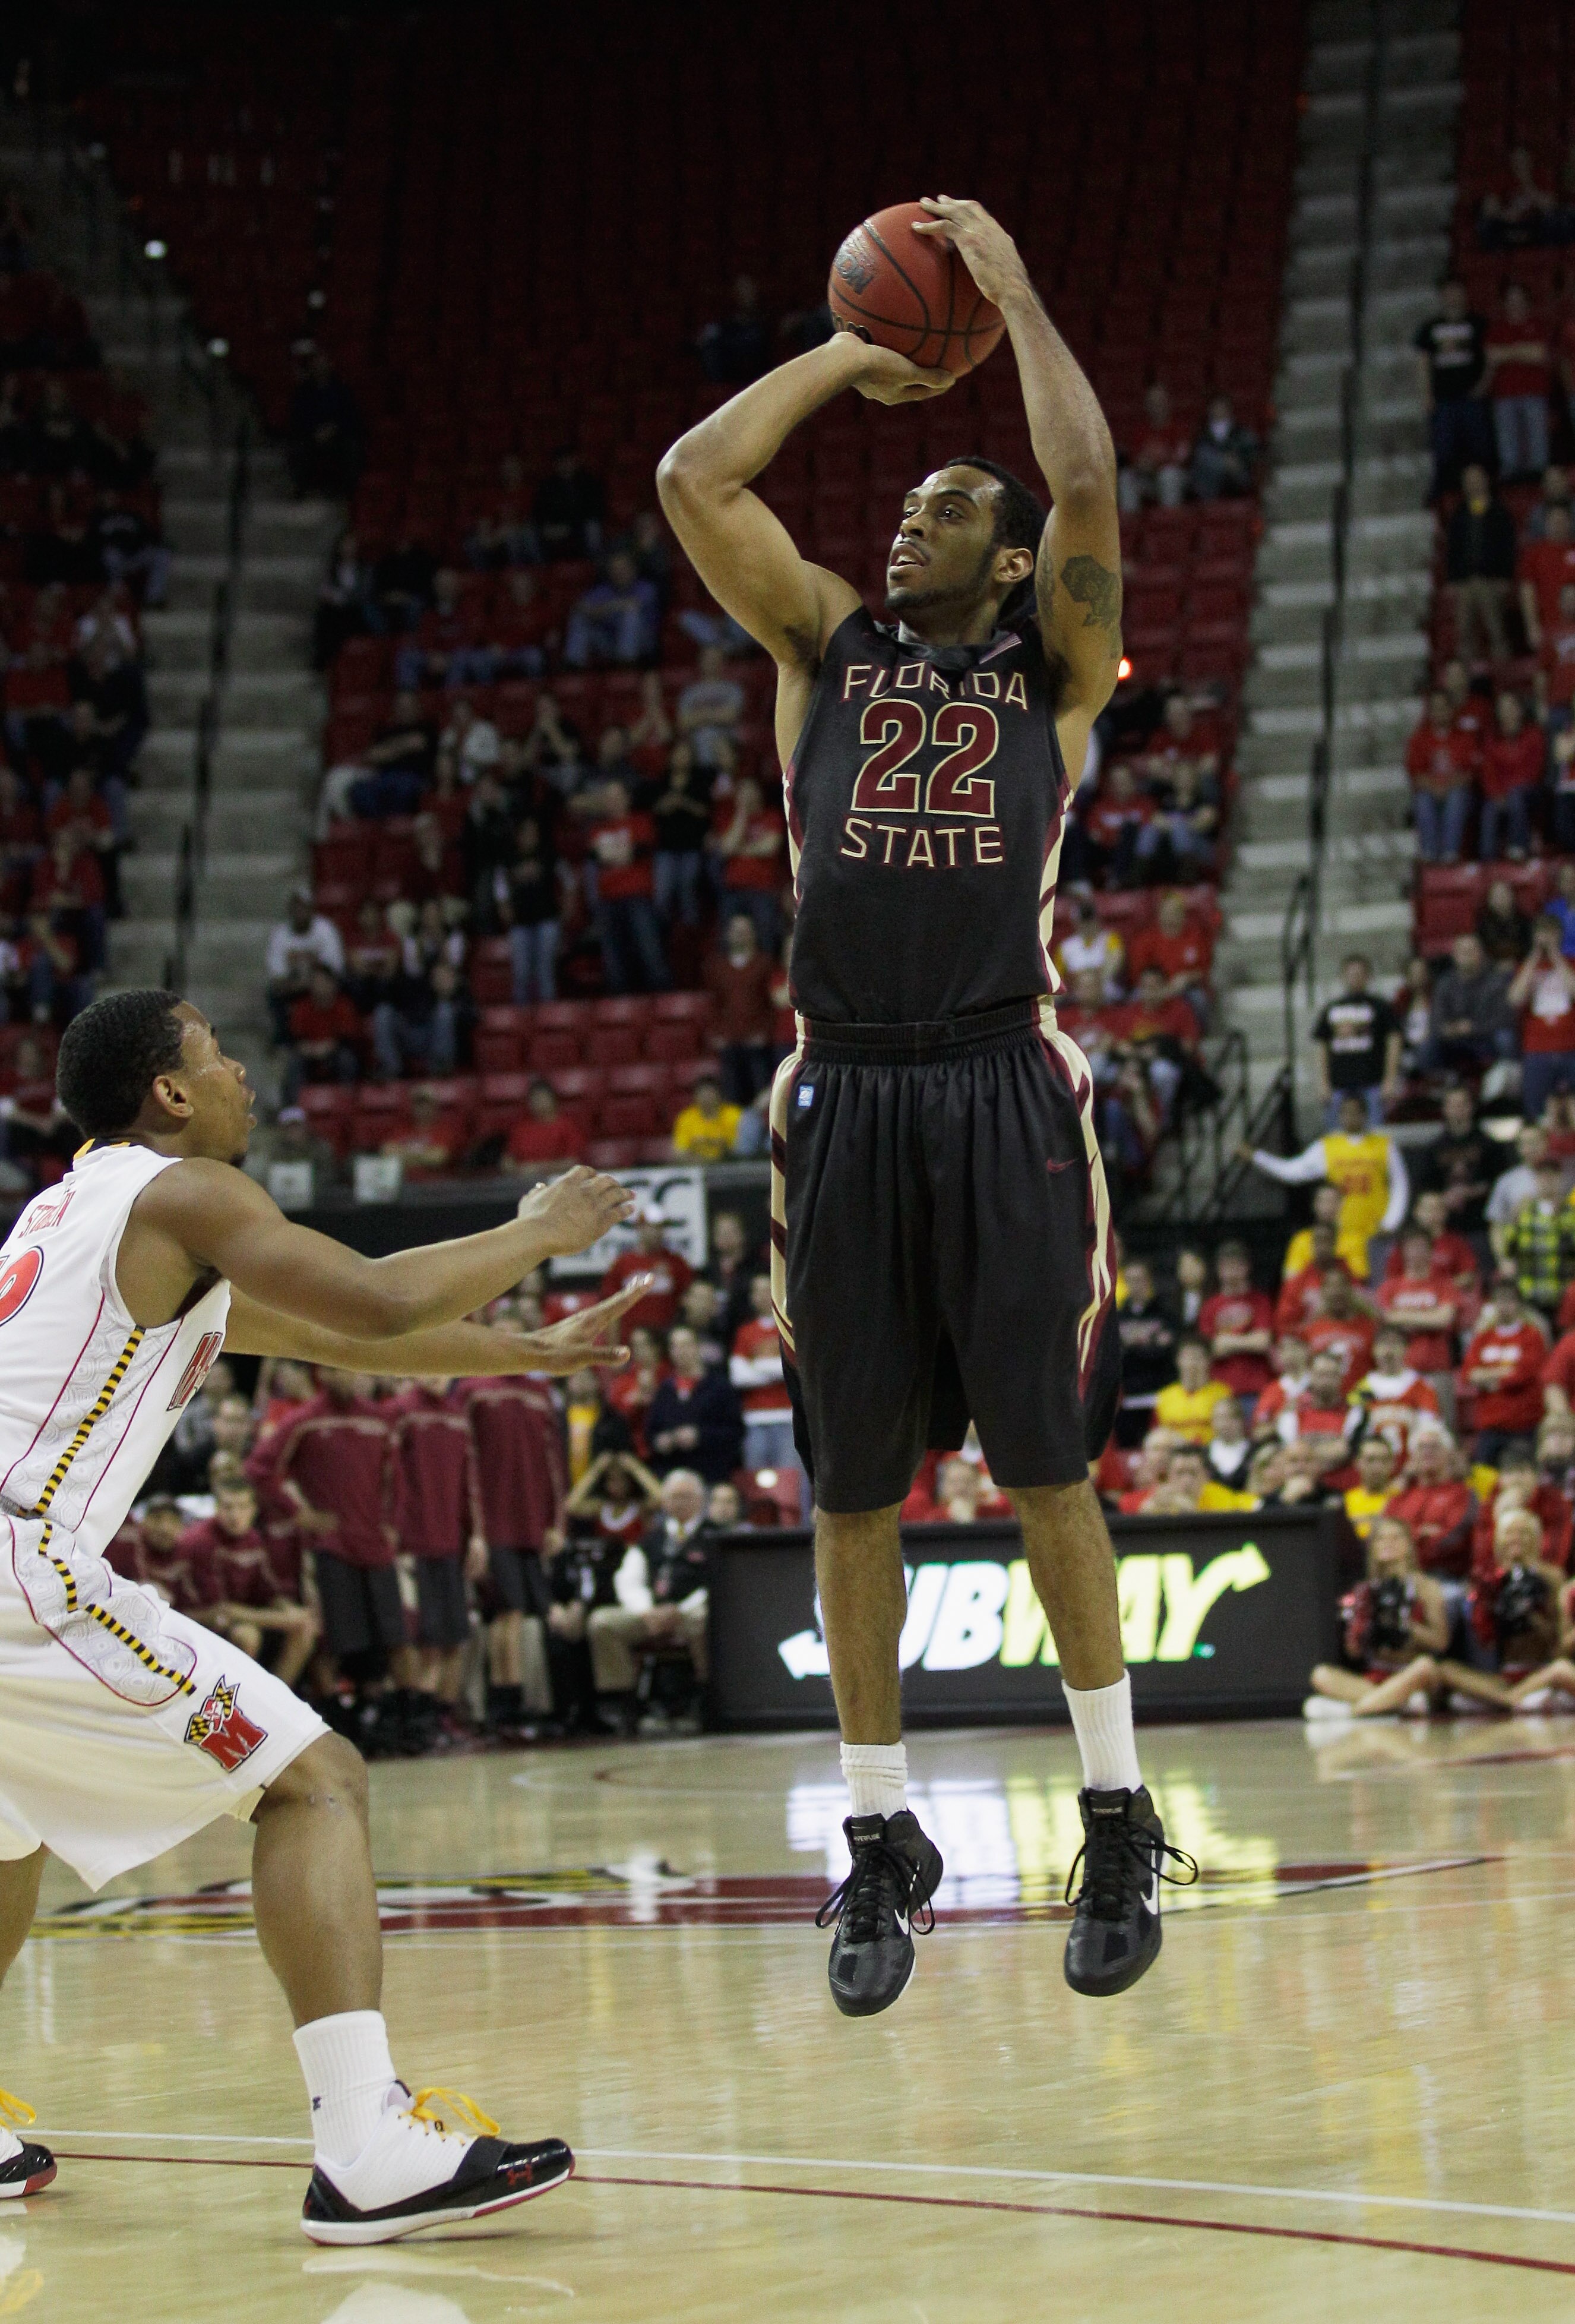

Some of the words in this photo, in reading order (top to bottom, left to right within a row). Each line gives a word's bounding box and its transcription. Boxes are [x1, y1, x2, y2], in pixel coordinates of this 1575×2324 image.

[842, 662, 1029, 711] FLORIDA
[850, 698, 1000, 818] 22
[840, 817, 1004, 867] STATE
